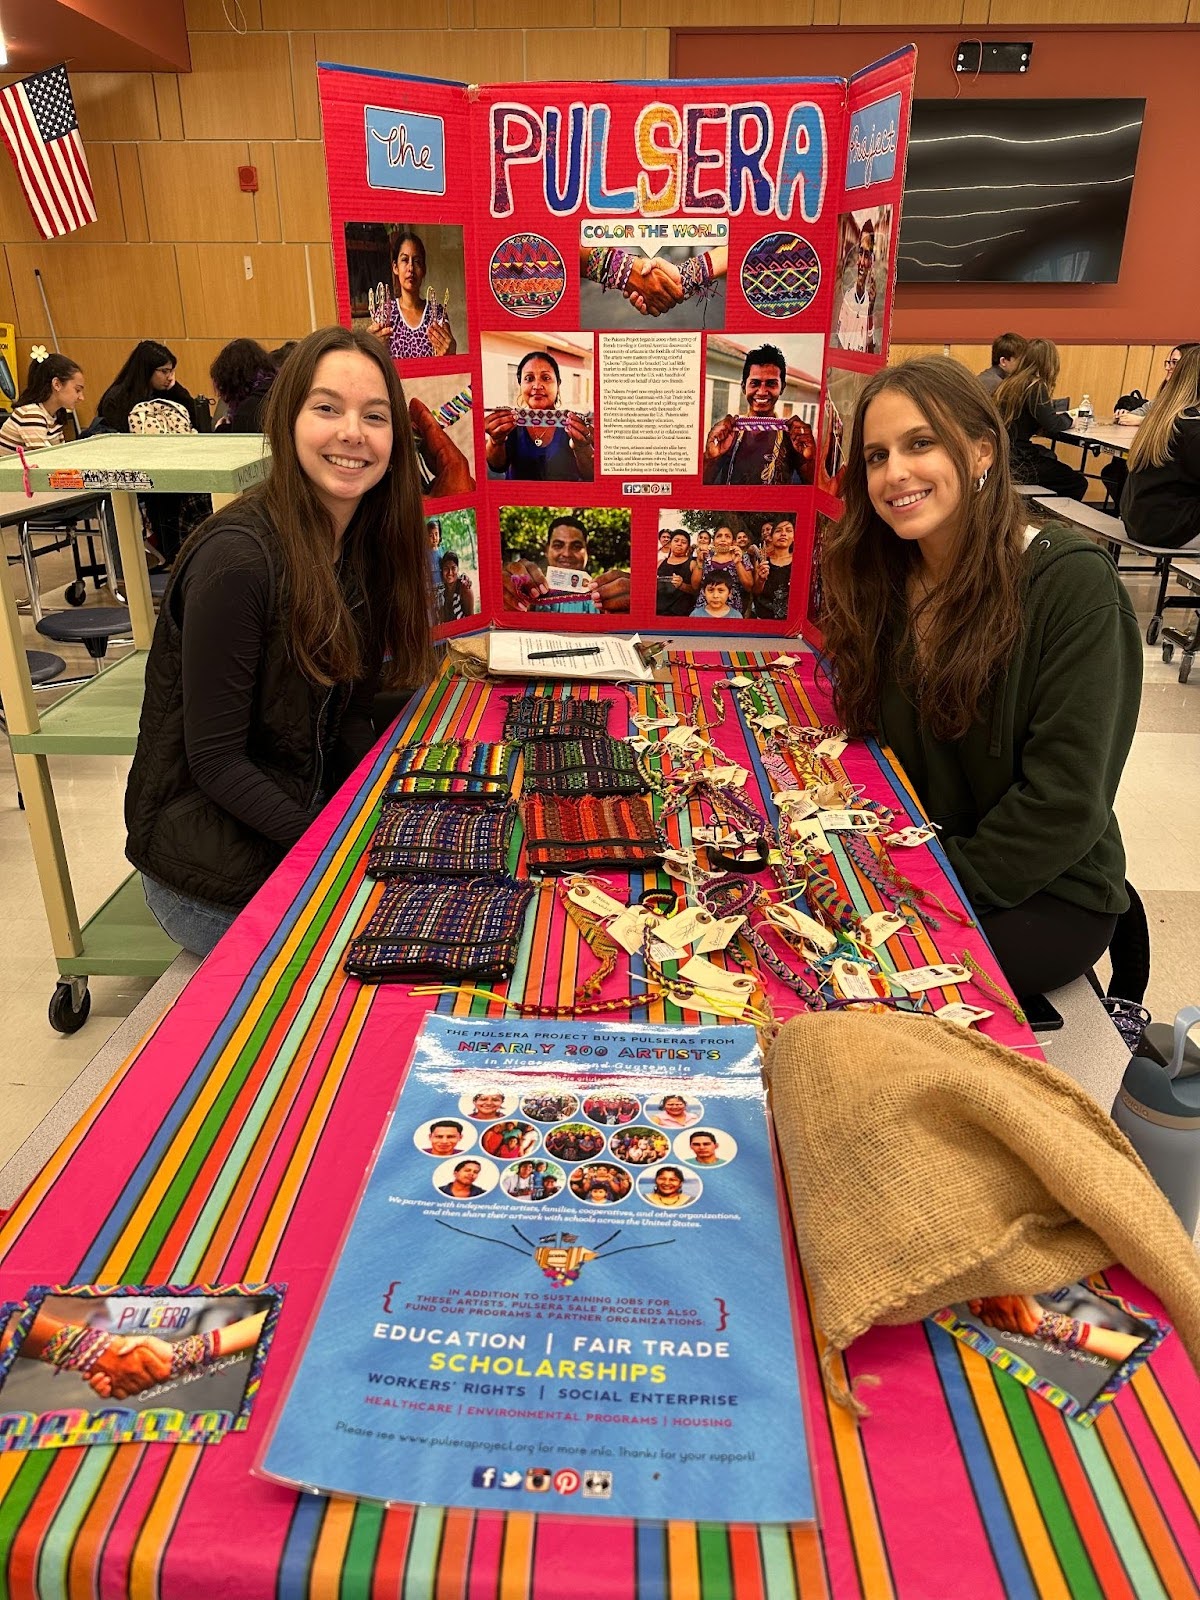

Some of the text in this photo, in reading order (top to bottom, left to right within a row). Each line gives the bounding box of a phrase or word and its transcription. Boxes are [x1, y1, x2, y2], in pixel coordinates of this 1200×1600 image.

[371, 123, 435, 171] The
[849, 120, 896, 189] Project
[489, 100, 827, 223] PULSERA
[583, 223, 728, 239] COLOR THE WORLD
[458, 1041, 721, 1060] NEARLY 200 ARTISTS
[534, 1032, 588, 1040] PROJECT
[632, 1036, 695, 1044] PULSERAS
[389, 1196, 741, 1222] We partner with independent artists, families, cooperatives, and other organizations,
[423, 1208, 442, 1216] and
[442, 1209, 461, 1217] then
[462, 1210, 486, 1218] share
[486, 1212, 508, 1220] their
[508, 1213, 542, 1221] artwork
[544, 1214, 563, 1222] with
[564, 1215, 596, 1224] schools
[597, 1217, 625, 1225] across
[626, 1218, 640, 1226] the
[672, 1220, 702, 1228] States.
[417, 1295, 452, 1304] THESE
[512, 1301, 563, 1310] PULSERA
[568, 1304, 598, 1312] SALE
[602, 1306, 662, 1315] PROCEEDS
[450, 1288, 460, 1296] IN
[464, 1290, 519, 1299] ADDITION
[524, 1292, 540, 1300] TO
[544, 1293, 612, 1304] SUSTAINING
[616, 1298, 644, 1306] JOBS
[117, 1306, 190, 1330] PULSERA
[406, 1302, 436, 1312] FUND
[441, 1306, 465, 1314] OUR
[468, 1308, 531, 1318] PROGRAMS
[548, 1312, 602, 1322] PARTNER
[606, 1315, 705, 1326] ORGANIZATIONS:
[373, 1322, 526, 1350] EDUCATION
[574, 1336, 632, 1355] FAIR
[642, 1340, 730, 1358] TRADE
[1000, 1330, 1039, 1348] Color
[1043, 1343, 1065, 1356] the
[138, 1351, 246, 1402] Color the World
[429, 1352, 667, 1383] SCHOLARSHIPS
[368, 1372, 457, 1392] WORKERS'
[464, 1382, 526, 1397] RIGHTS
[558, 1388, 622, 1402] SOCIAL
[630, 1392, 739, 1406] ENTERPRISE
[364, 1396, 453, 1414] HEALTHCARE
[467, 1406, 580, 1421] ENVIRONMENTAL
[586, 1413, 658, 1425] PROGRAMS
[672, 1417, 733, 1428] HOUSING
[336, 1420, 373, 1438] Please
[376, 1432, 396, 1440] see
[400, 1433, 535, 1454] www.pulseraproject.org
[537, 1442, 556, 1452] for
[557, 1446, 587, 1456] more
[619, 1446, 659, 1459] Thanks
[660, 1449, 676, 1460] for
[680, 1452, 706, 1464] your
[709, 1452, 756, 1463] support!
